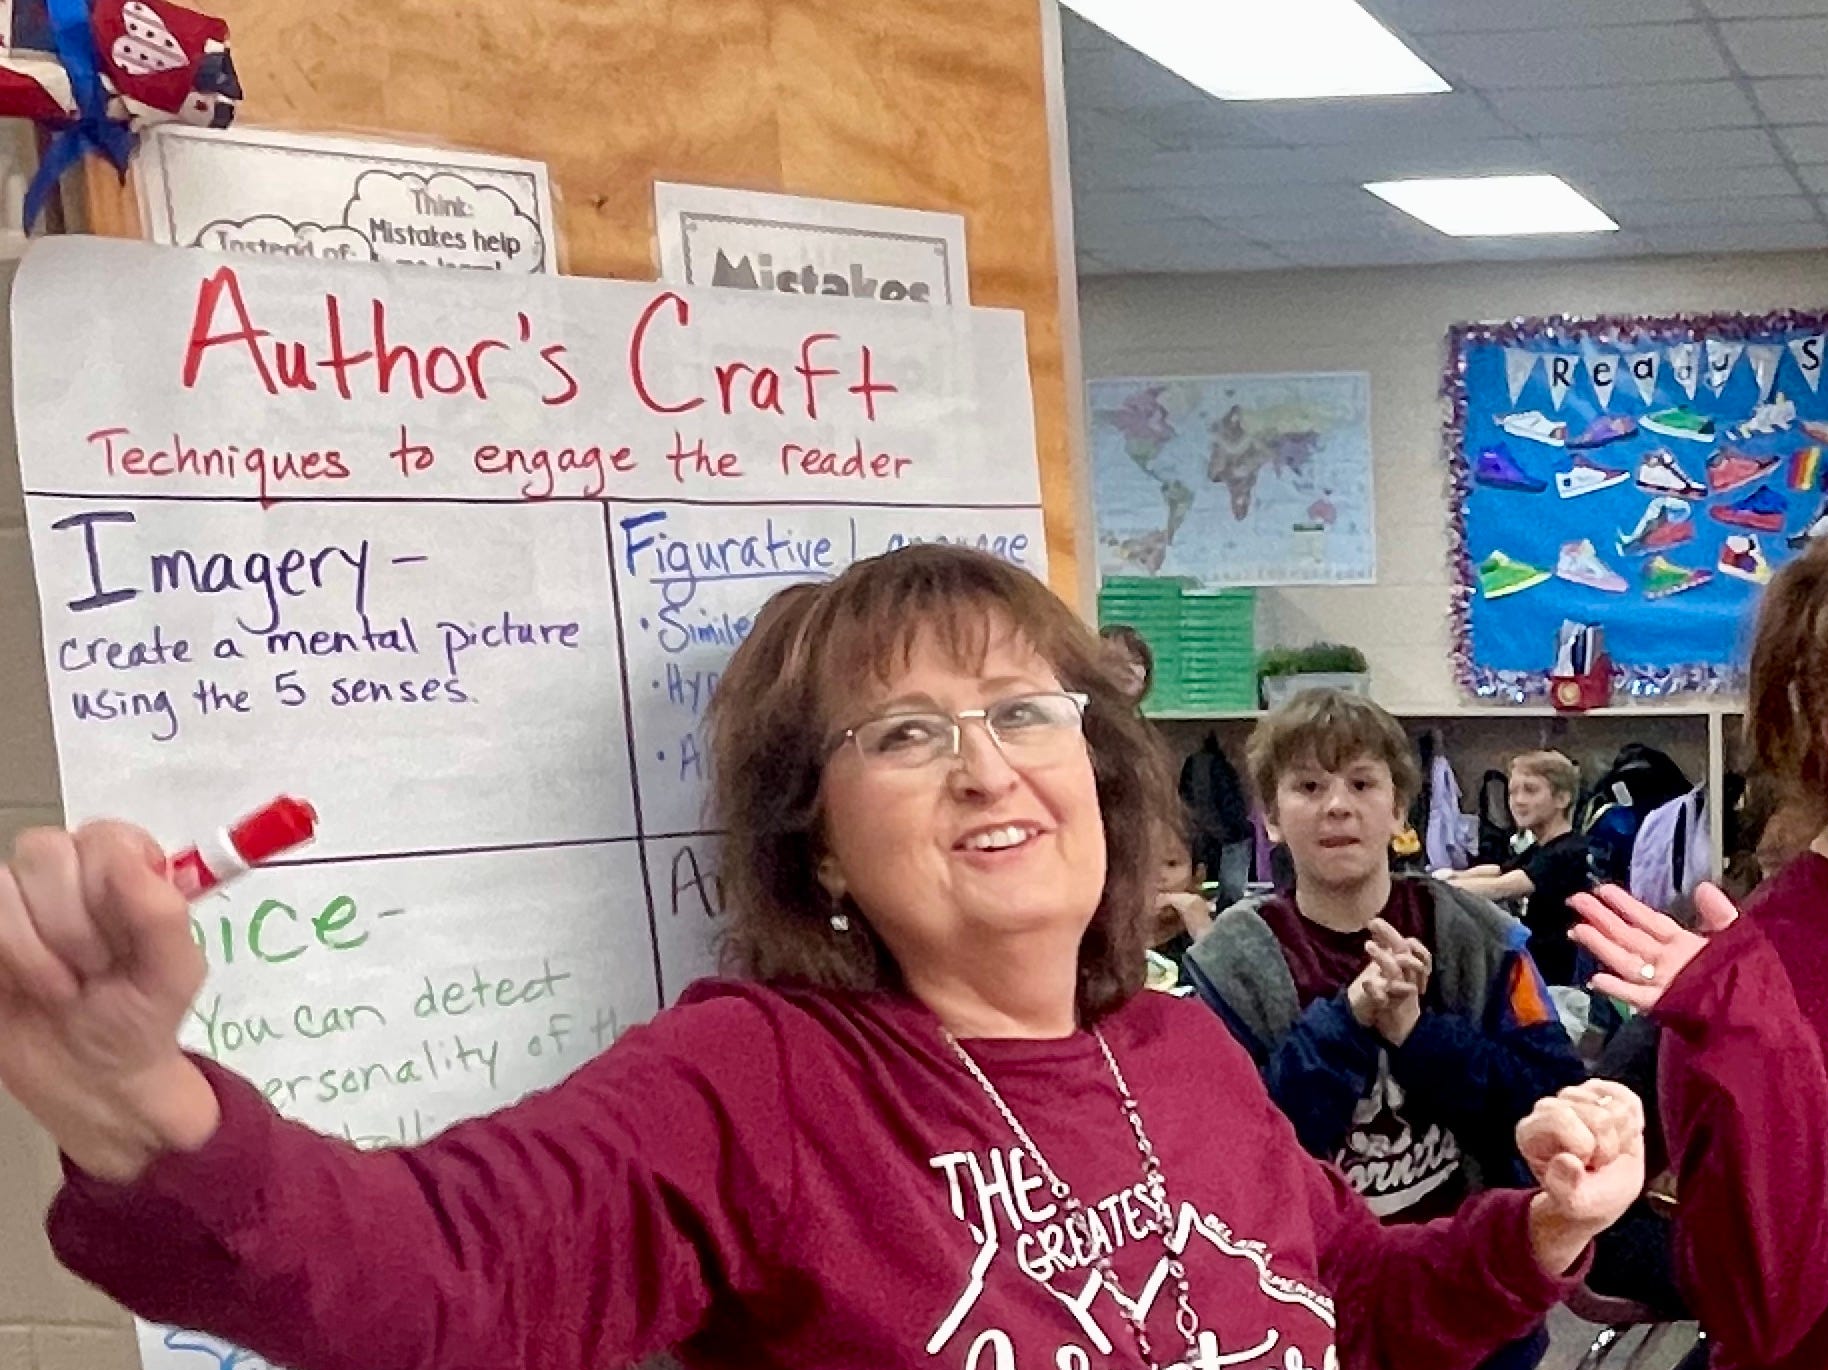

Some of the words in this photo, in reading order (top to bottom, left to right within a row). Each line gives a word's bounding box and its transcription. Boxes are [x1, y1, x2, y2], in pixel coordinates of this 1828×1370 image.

[369, 217, 466, 251] Mistakes
[472, 228, 521, 260] help
[181, 265, 580, 405] Author's
[629, 291, 899, 421] Craft
[86, 425, 351, 510] Techniques
[390, 424, 435, 471] to
[475, 446, 638, 499] engage
[665, 428, 745, 484] the
[780, 437, 914, 480] reader
[619, 510, 835, 607] Figurative
[58, 625, 194, 672] create
[213, 635, 245, 660] a
[267, 615, 421, 657] mental
[436, 610, 581, 677] picture
[72, 687, 179, 742] using
[193, 678, 251, 715] the
[273, 671, 307, 707] 5
[191, 993, 285, 1058] You
[293, 1005, 387, 1039] can
[412, 957, 572, 1018] detect
[263, 1034, 499, 1109] ersonality
[526, 1012, 573, 1057] of
[928, 1147, 1058, 1245] THE
